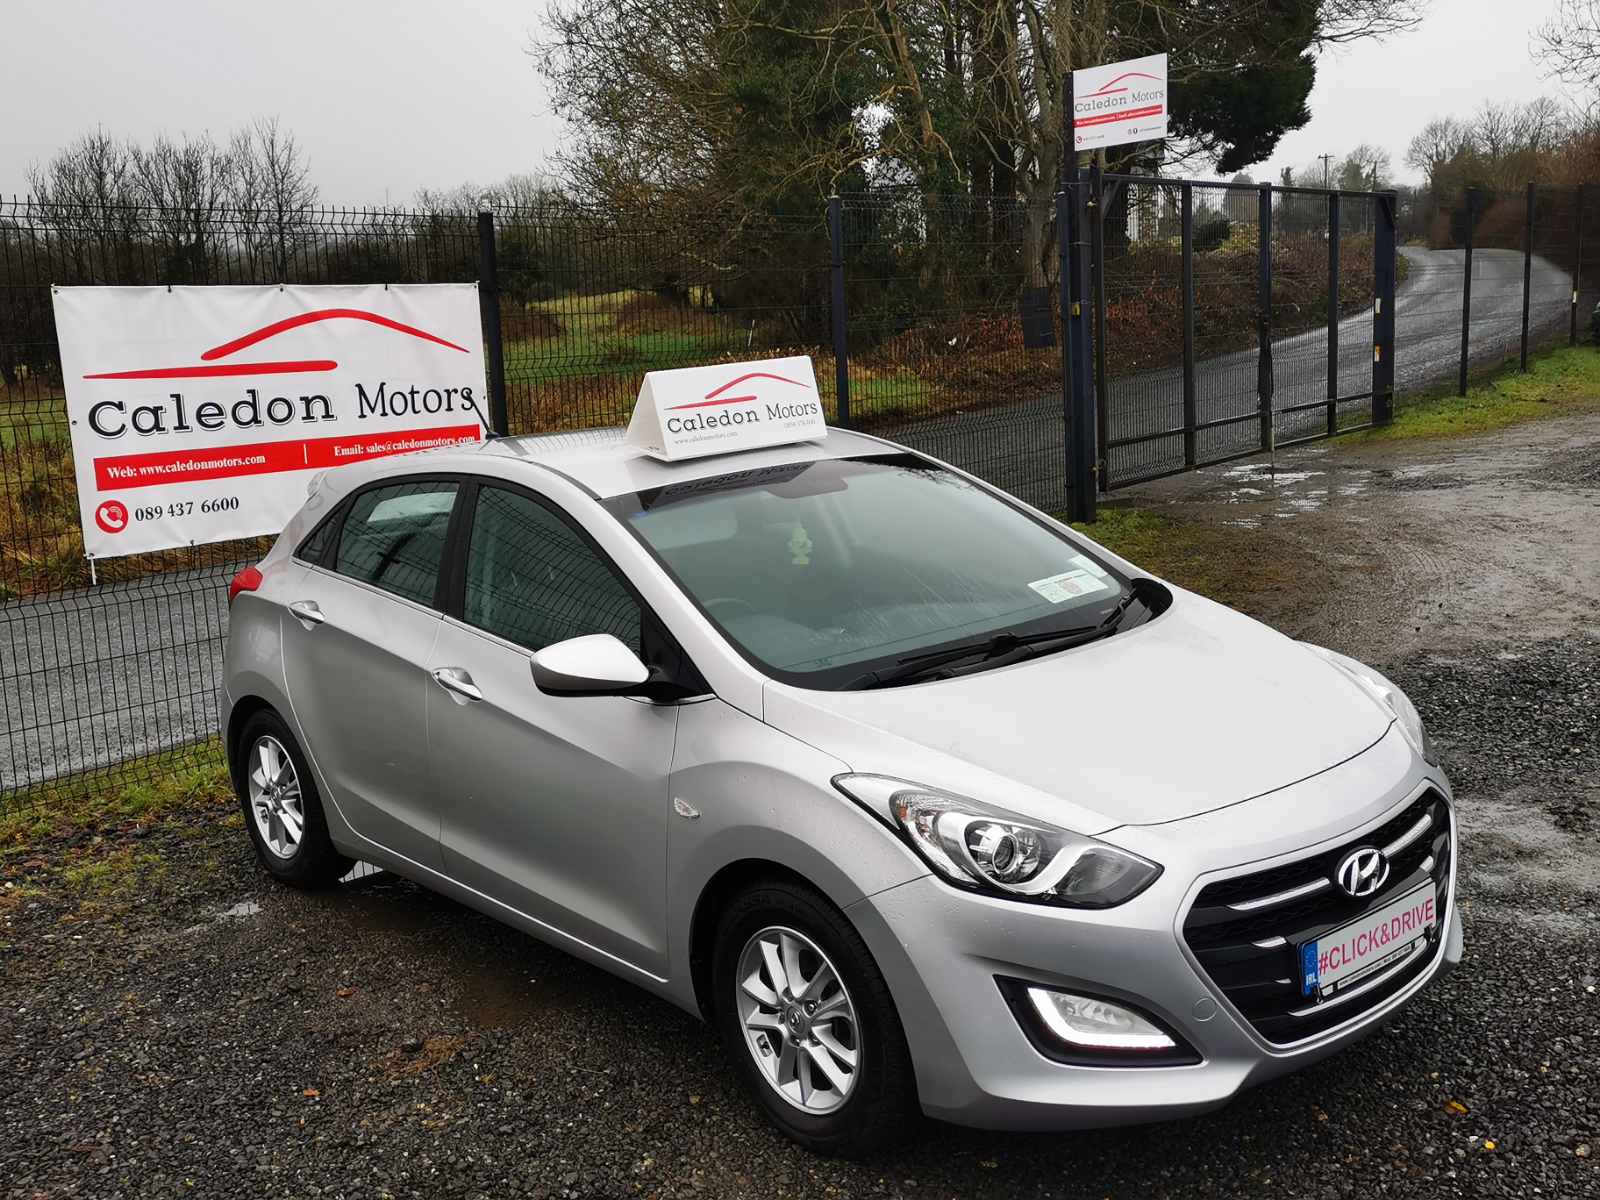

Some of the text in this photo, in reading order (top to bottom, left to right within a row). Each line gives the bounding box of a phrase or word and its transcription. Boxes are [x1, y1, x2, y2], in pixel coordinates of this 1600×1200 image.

[1074, 89, 1164, 112] Caledon Motors
[88, 381, 474, 439] Caledon Motors
[667, 409, 760, 434] Caledon
[765, 401, 819, 421] Motors
[334, 435, 475, 457] Email: sales@caledonmotors.com
[107, 454, 266, 480] Web: www.caledonmotors.com
[135, 496, 240, 521] 089 437 6600
[1318, 898, 1434, 976] #CLICK&DRIVE
